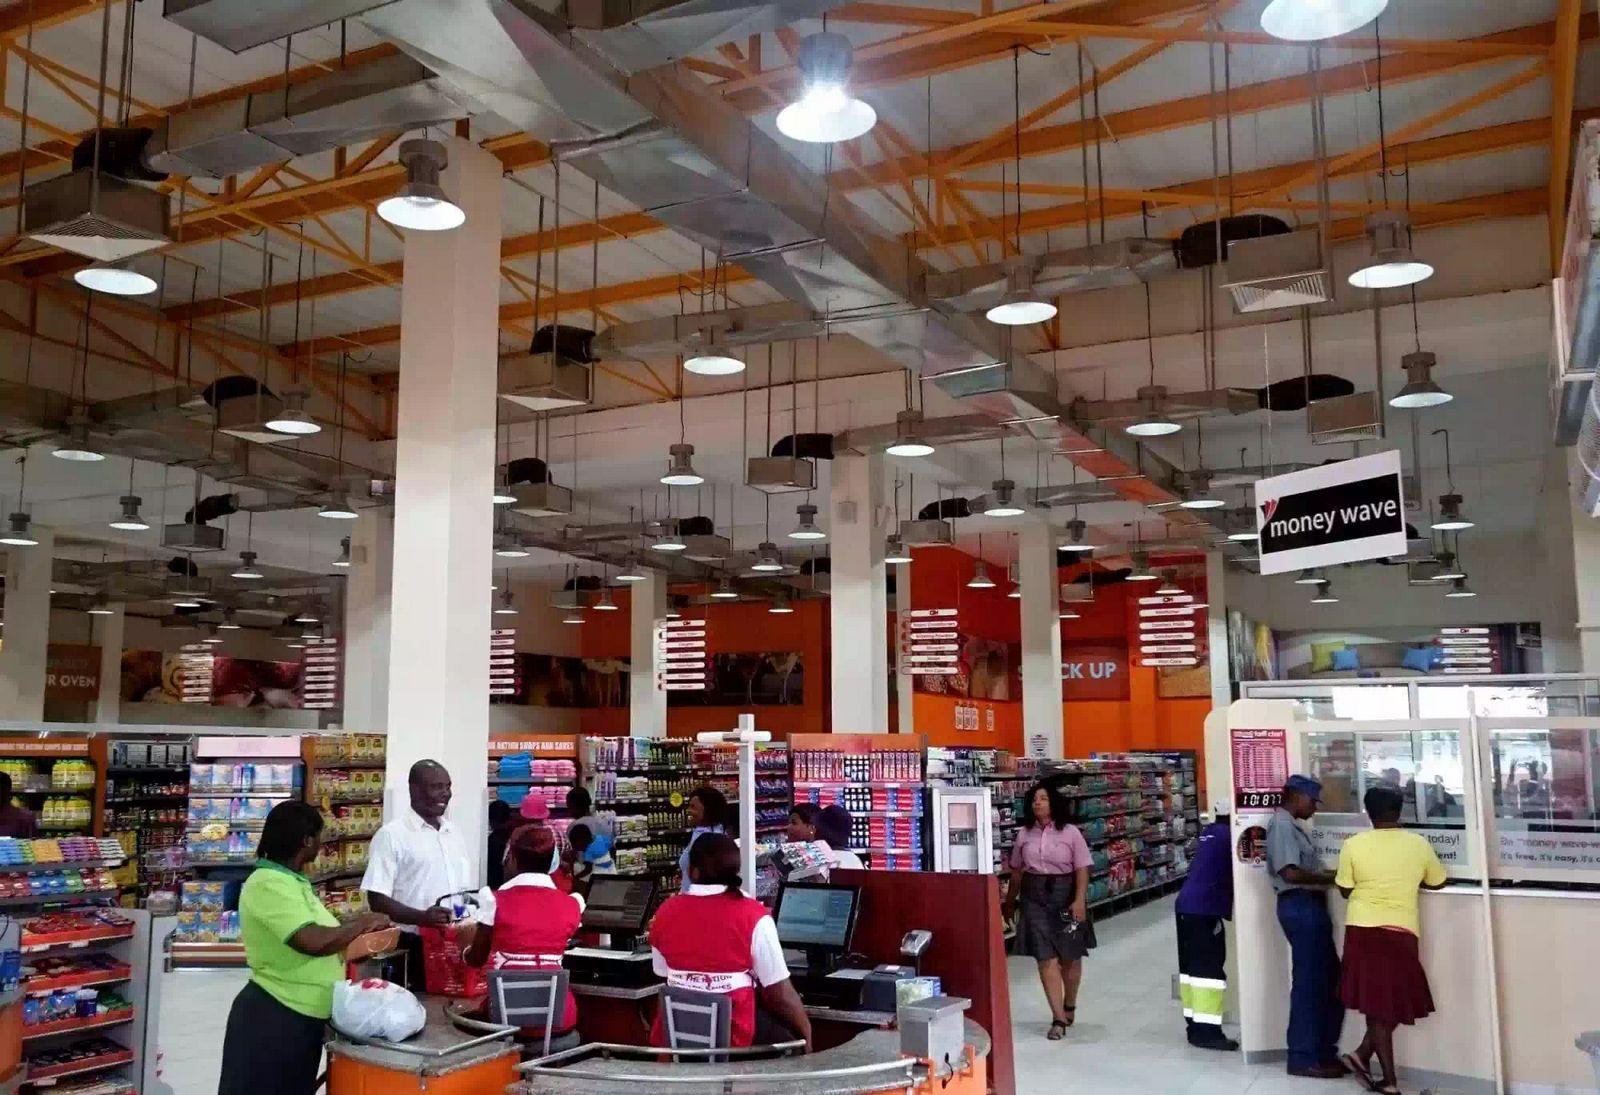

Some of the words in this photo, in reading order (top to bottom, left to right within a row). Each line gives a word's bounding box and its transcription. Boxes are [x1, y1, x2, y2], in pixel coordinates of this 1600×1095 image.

[1270, 510, 1335, 537] money
[1340, 500, 1396, 524] wave
[1089, 661, 1117, 679] UP
[59, 674, 97, 688] OVEN
[1427, 834, 1460, 846] today!
